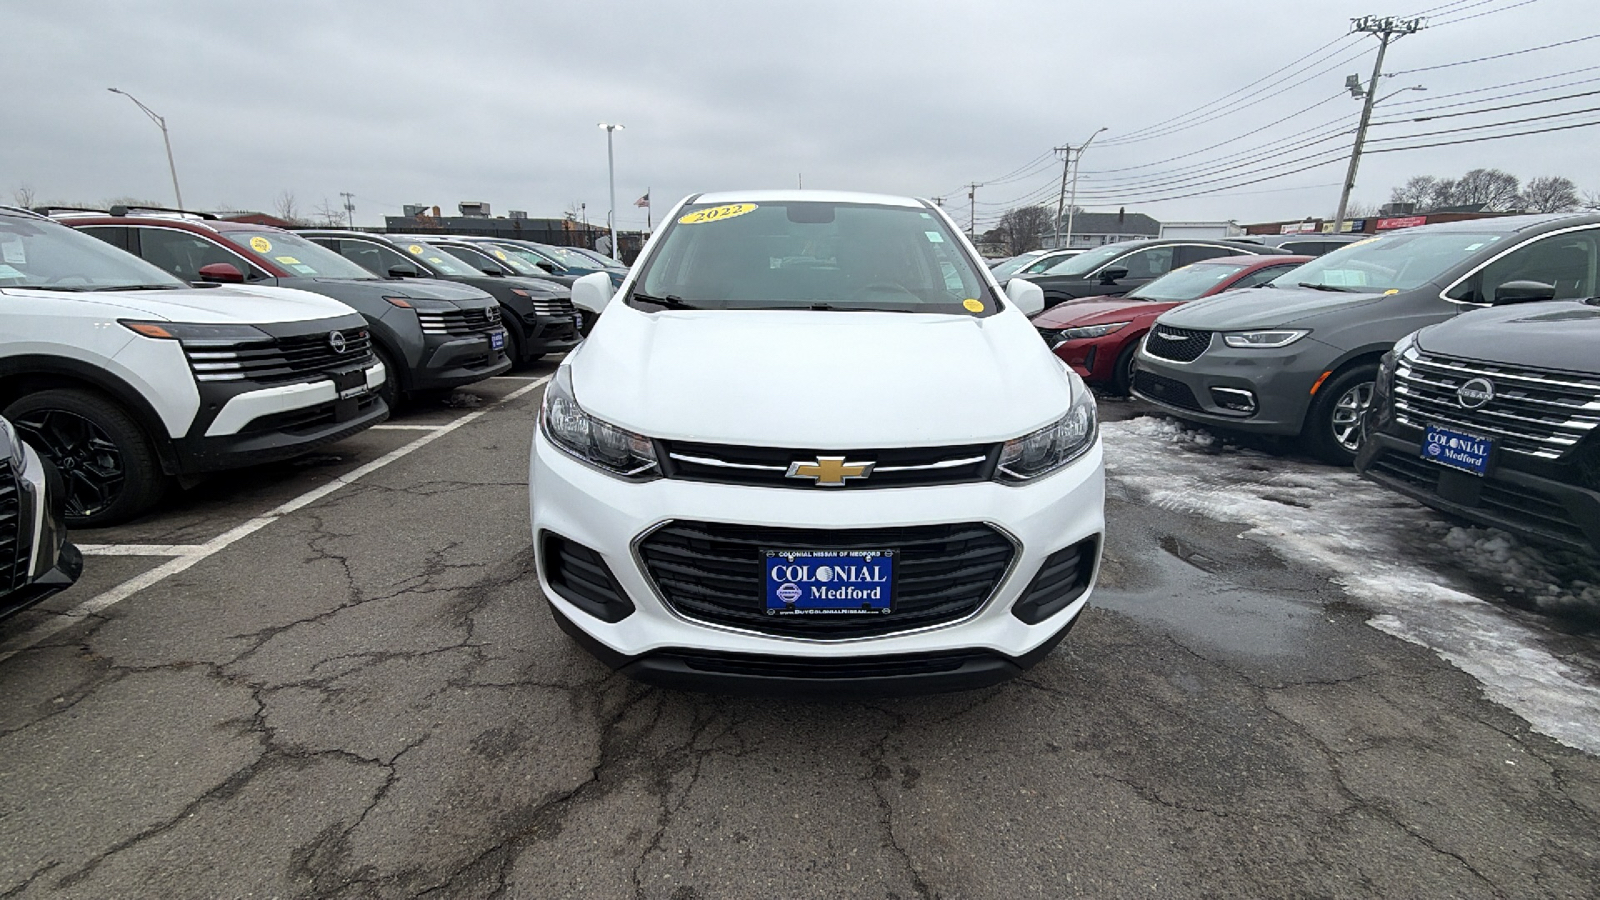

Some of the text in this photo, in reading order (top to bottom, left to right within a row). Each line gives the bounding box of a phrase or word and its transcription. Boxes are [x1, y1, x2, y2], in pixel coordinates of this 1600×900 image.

[694, 205, 743, 222] 2022
[1427, 432, 1487, 456] COLONIAL
[1443, 448, 1483, 466] Medford
[771, 564, 887, 582] COLONIAL
[810, 586, 881, 600] Medford
